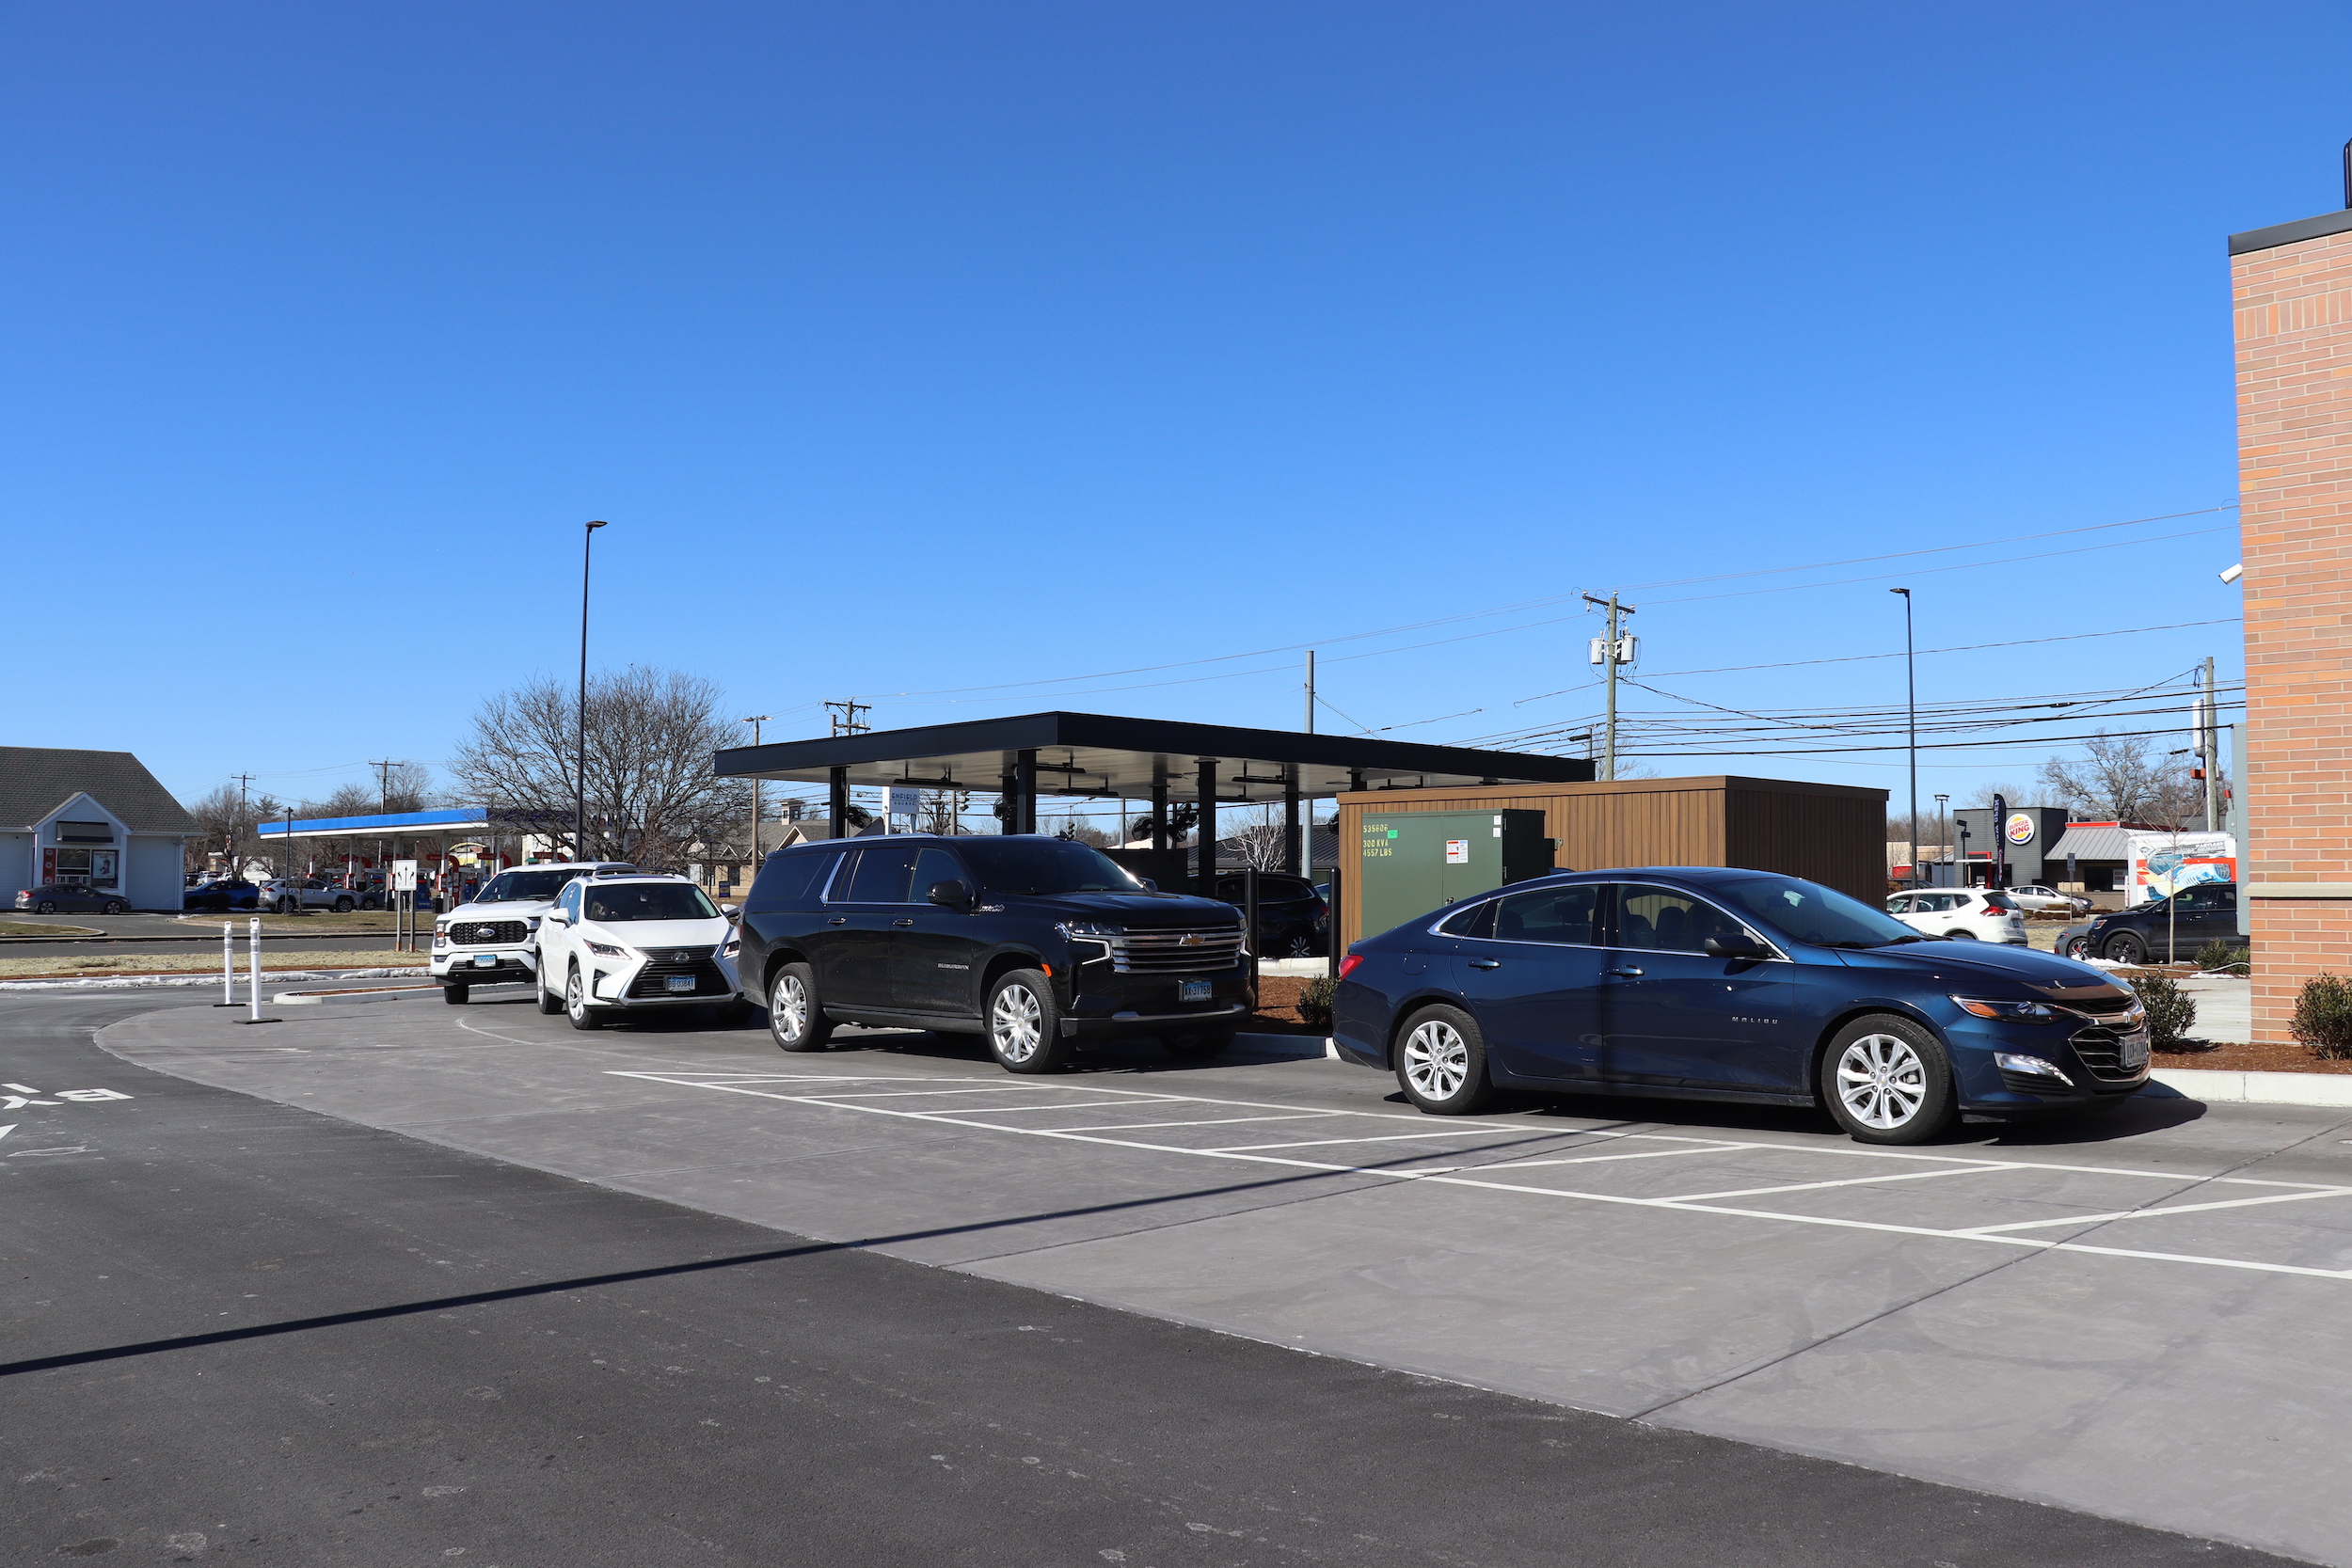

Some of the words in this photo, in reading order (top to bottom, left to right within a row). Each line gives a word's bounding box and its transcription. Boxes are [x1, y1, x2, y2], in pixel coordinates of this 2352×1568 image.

[891, 792, 918, 800] ENFIELD
[1363, 824, 1389, 833] 535606
[2009, 819, 2028, 831] BURGER
[2010, 824, 2030, 836] KING
[1363, 839, 1375, 847] 300
[1376, 839, 1389, 847] KVA
[1363, 848, 1379, 857] 4557
[1380, 847, 1392, 857] LBS
[1731, 1016, 1778, 1025] MALIBU
